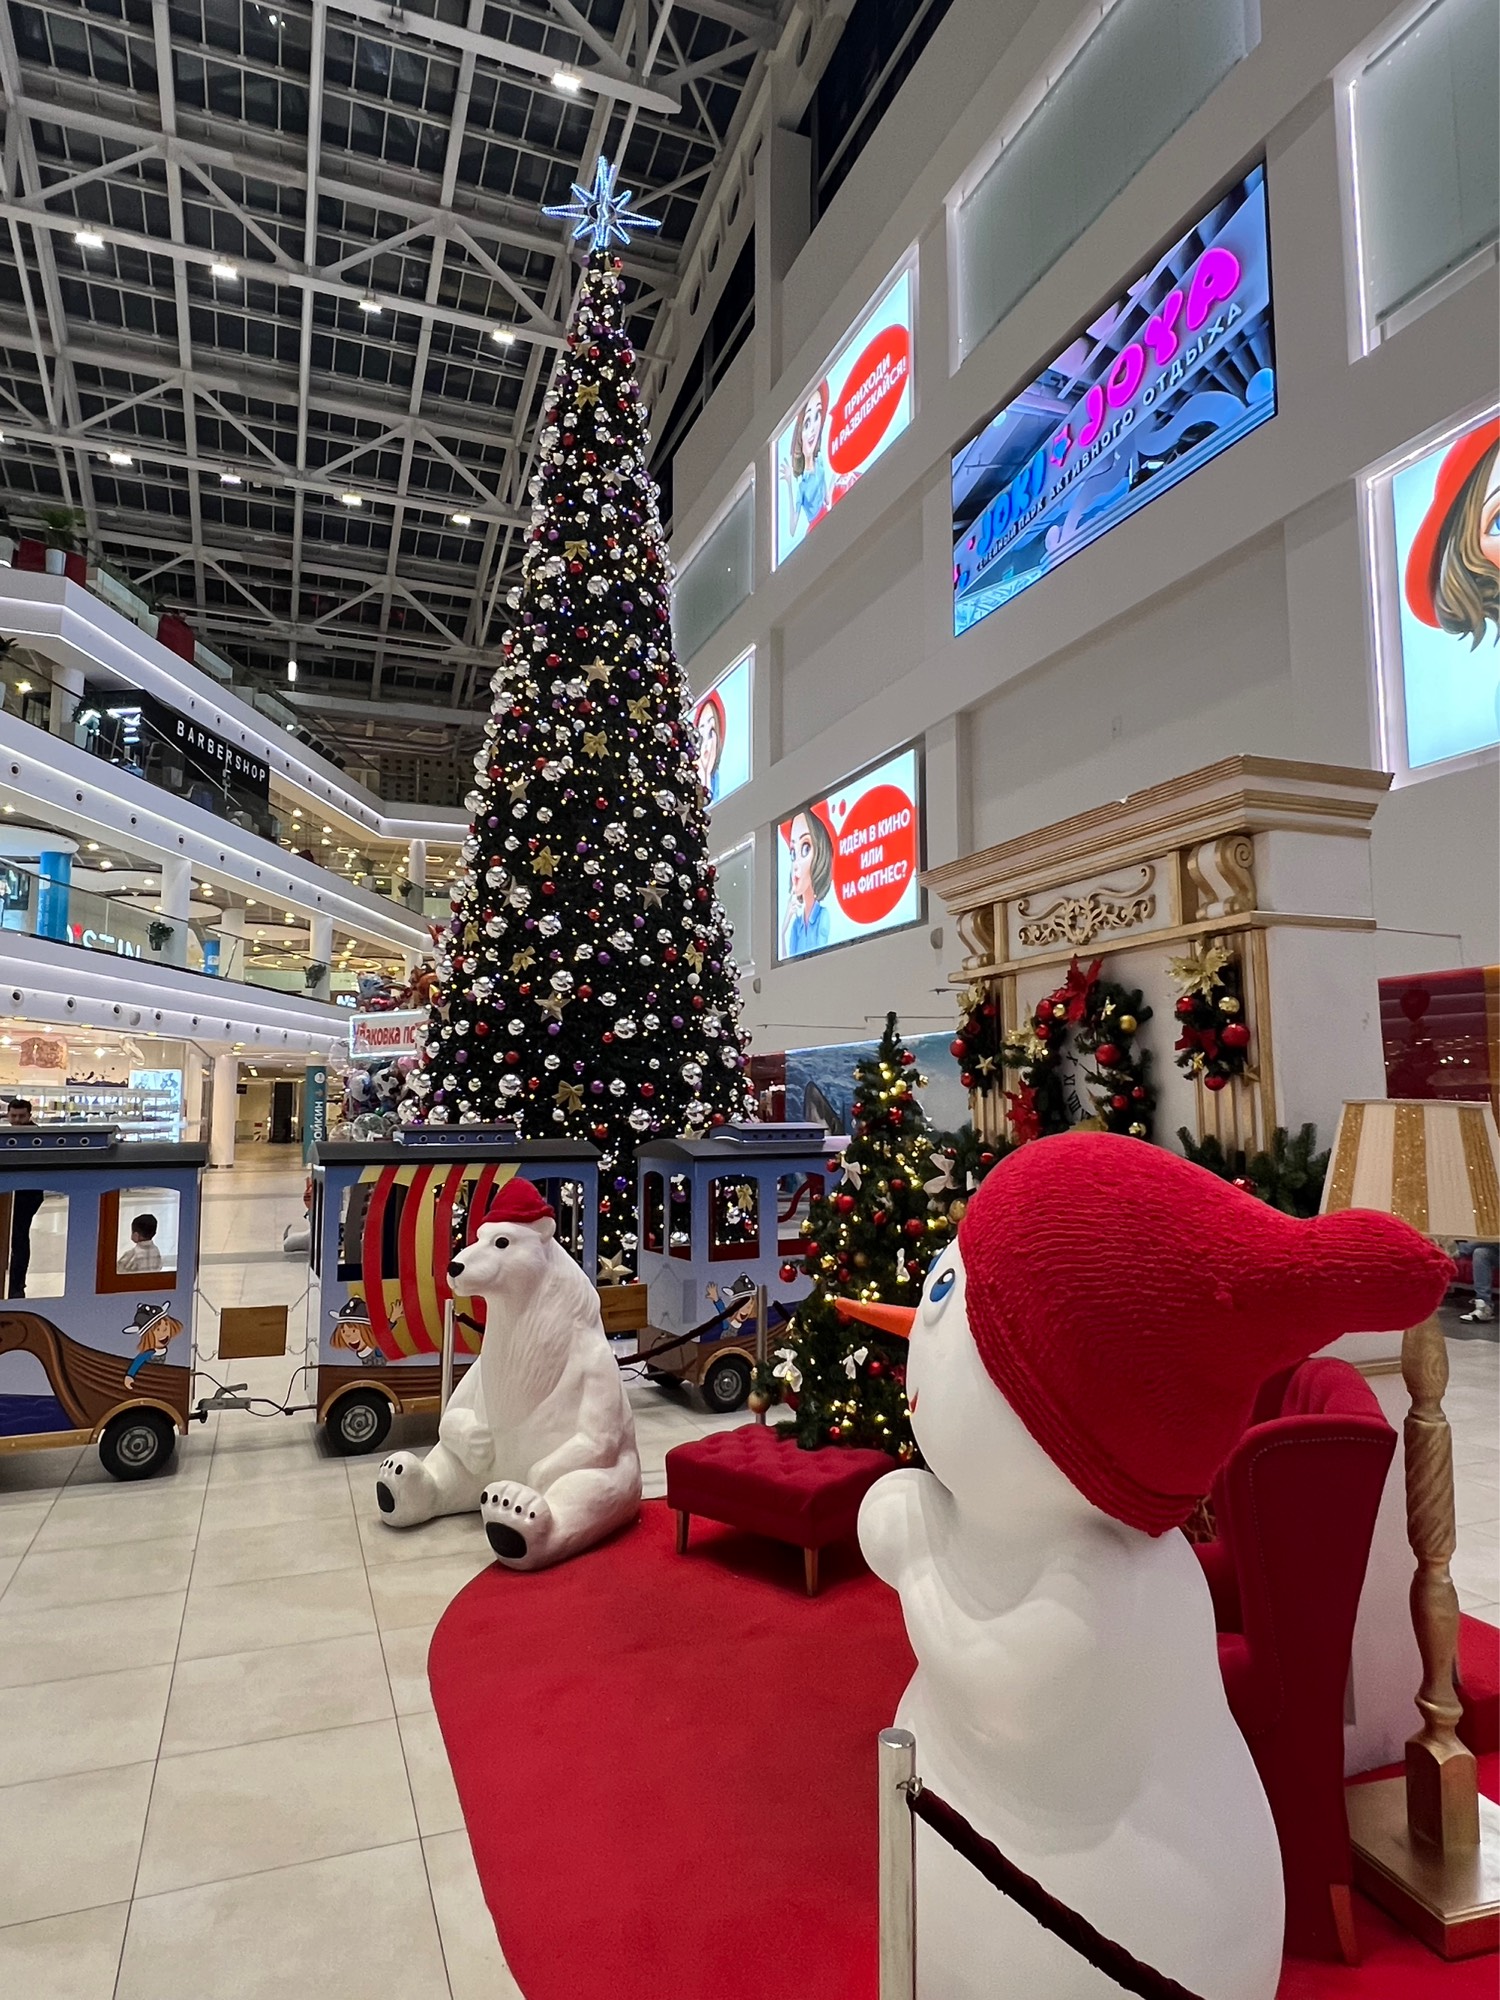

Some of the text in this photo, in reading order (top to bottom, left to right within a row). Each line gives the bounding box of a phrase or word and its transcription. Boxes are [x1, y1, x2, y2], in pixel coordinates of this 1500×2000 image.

[831, 355, 907, 456] И РАЗВЛЕКАЙСЯ!
[844, 353, 891, 420] ПРИХОДИ
[1019, 496, 1046, 531] ПАРК
[1049, 408, 1134, 501] АКТИВНОГО
[1143, 302, 1242, 406] ОТДЫХА
[977, 449, 1046, 556] JOKI
[176, 720, 267, 783] BARBERSHOP
[839, 808, 911, 856] ИДЁМ В КИНО
[860, 844, 883, 870] ИЛИ
[842, 859, 908, 900] НА ФИТНЕС?
[309, 1101, 324, 1142] ОЙКИН
